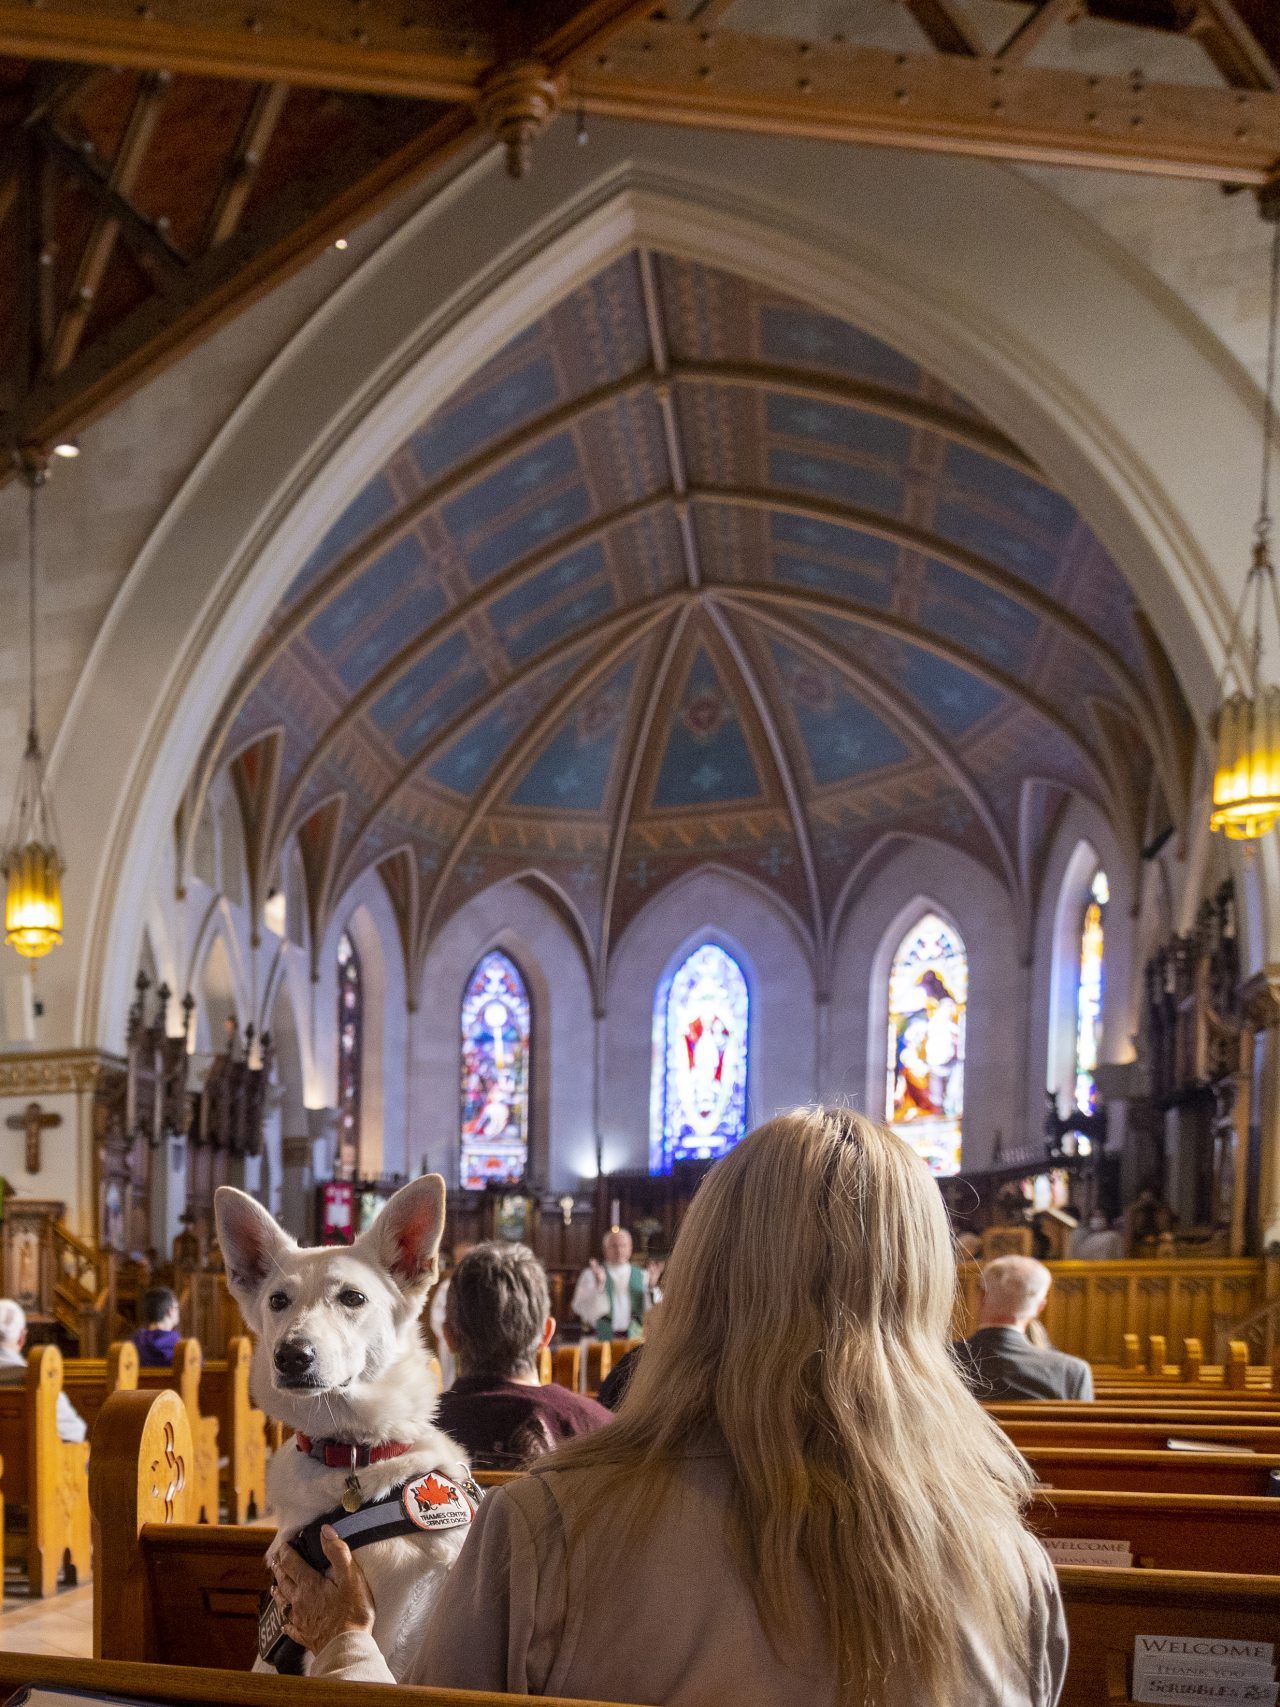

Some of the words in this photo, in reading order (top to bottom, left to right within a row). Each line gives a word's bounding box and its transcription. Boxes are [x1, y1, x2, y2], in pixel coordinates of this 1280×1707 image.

[420, 1512, 446, 1521] THAMES
[1044, 1541, 1127, 1552] WELCOME
[1142, 1639, 1265, 1658] WELCOME
